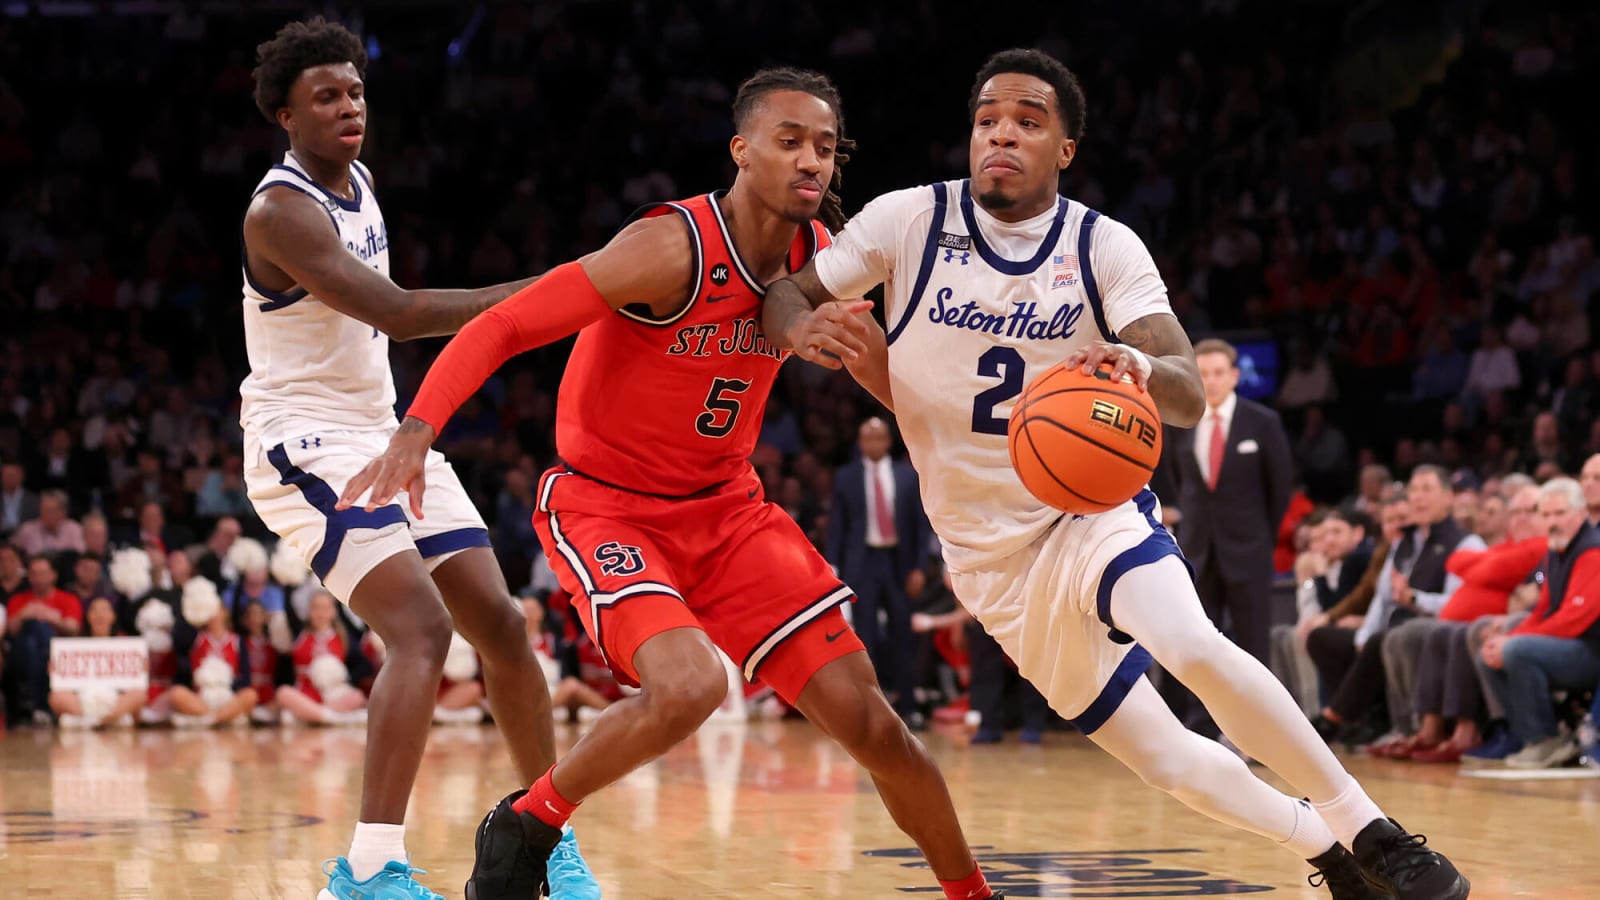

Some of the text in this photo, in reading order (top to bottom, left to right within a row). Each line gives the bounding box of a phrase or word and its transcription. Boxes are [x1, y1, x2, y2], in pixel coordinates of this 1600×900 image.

[938, 239, 969, 249] CHANGE
[945, 234, 960, 243] BE
[712, 268, 728, 280] JK
[1052, 279, 1078, 288] EAST
[1055, 273, 1074, 281] BIG
[929, 287, 1085, 340] Seton Hall
[666, 323, 720, 357] ST.
[694, 376, 754, 438] 5
[971, 345, 1026, 436] 2
[1091, 398, 1157, 449] ELITE
[594, 541, 646, 577] SJ
